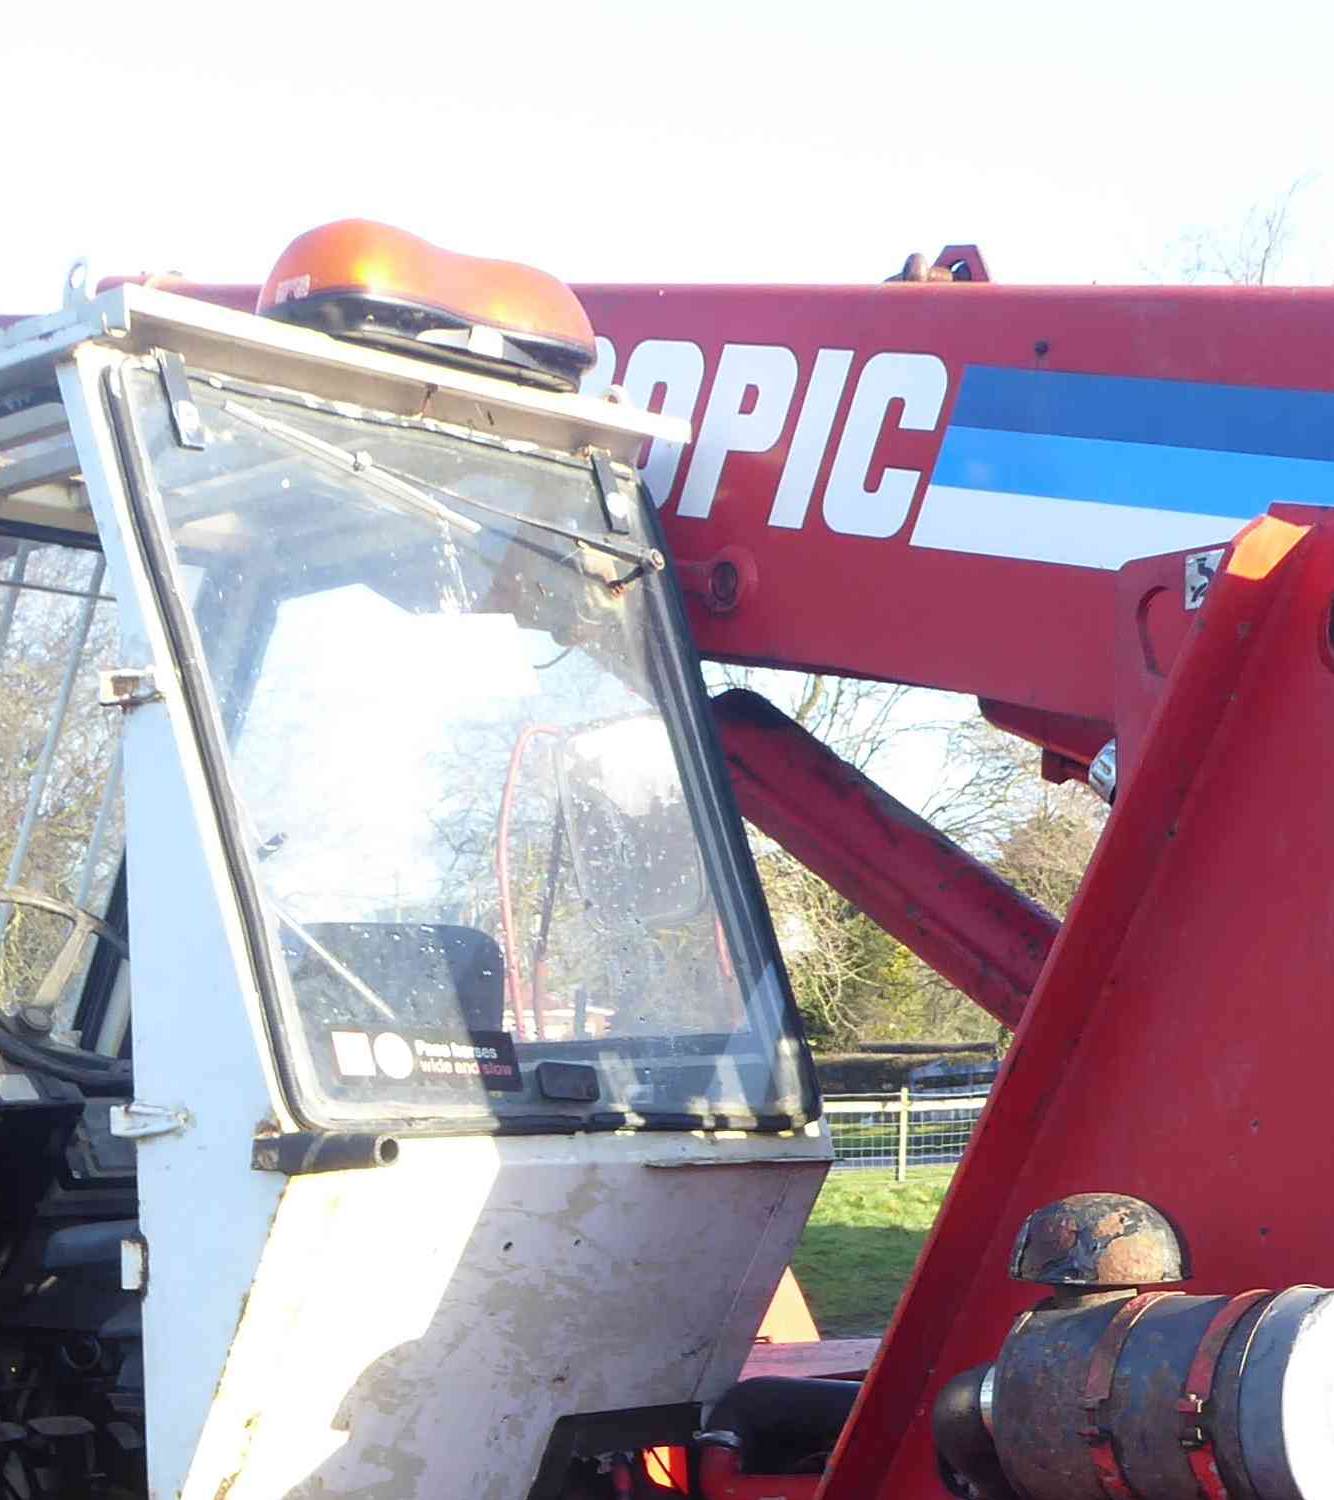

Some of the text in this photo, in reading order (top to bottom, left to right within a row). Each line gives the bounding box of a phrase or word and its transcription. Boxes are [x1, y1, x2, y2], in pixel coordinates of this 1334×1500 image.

[419, 1058, 513, 1076] wide and slow
